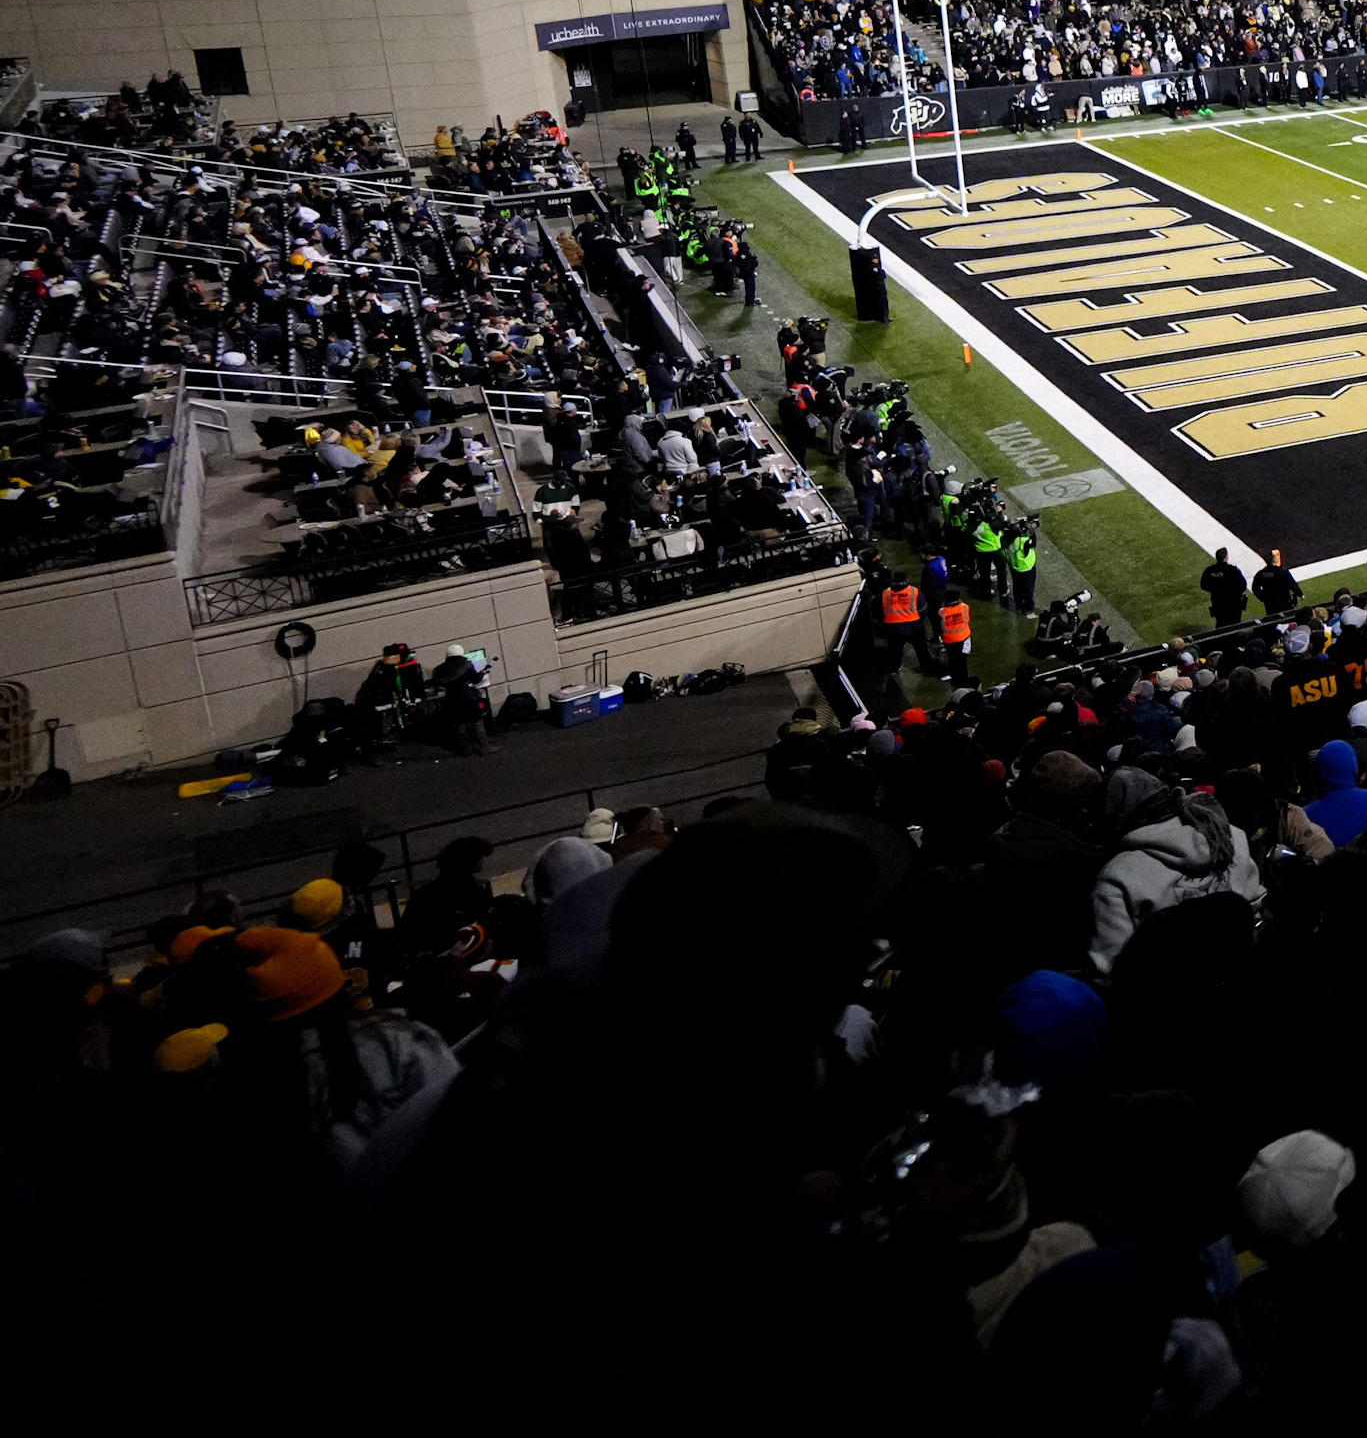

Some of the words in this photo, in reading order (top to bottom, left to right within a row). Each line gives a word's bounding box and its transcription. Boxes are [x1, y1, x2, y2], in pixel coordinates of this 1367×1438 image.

[623, 20, 643, 30] LIVE
[645, 14, 721, 28] EXTRAORDINARY
[550, 24, 600, 43] uchealth
[1102, 92, 1141, 105] MORE
[1289, 674, 1338, 708] ASU
